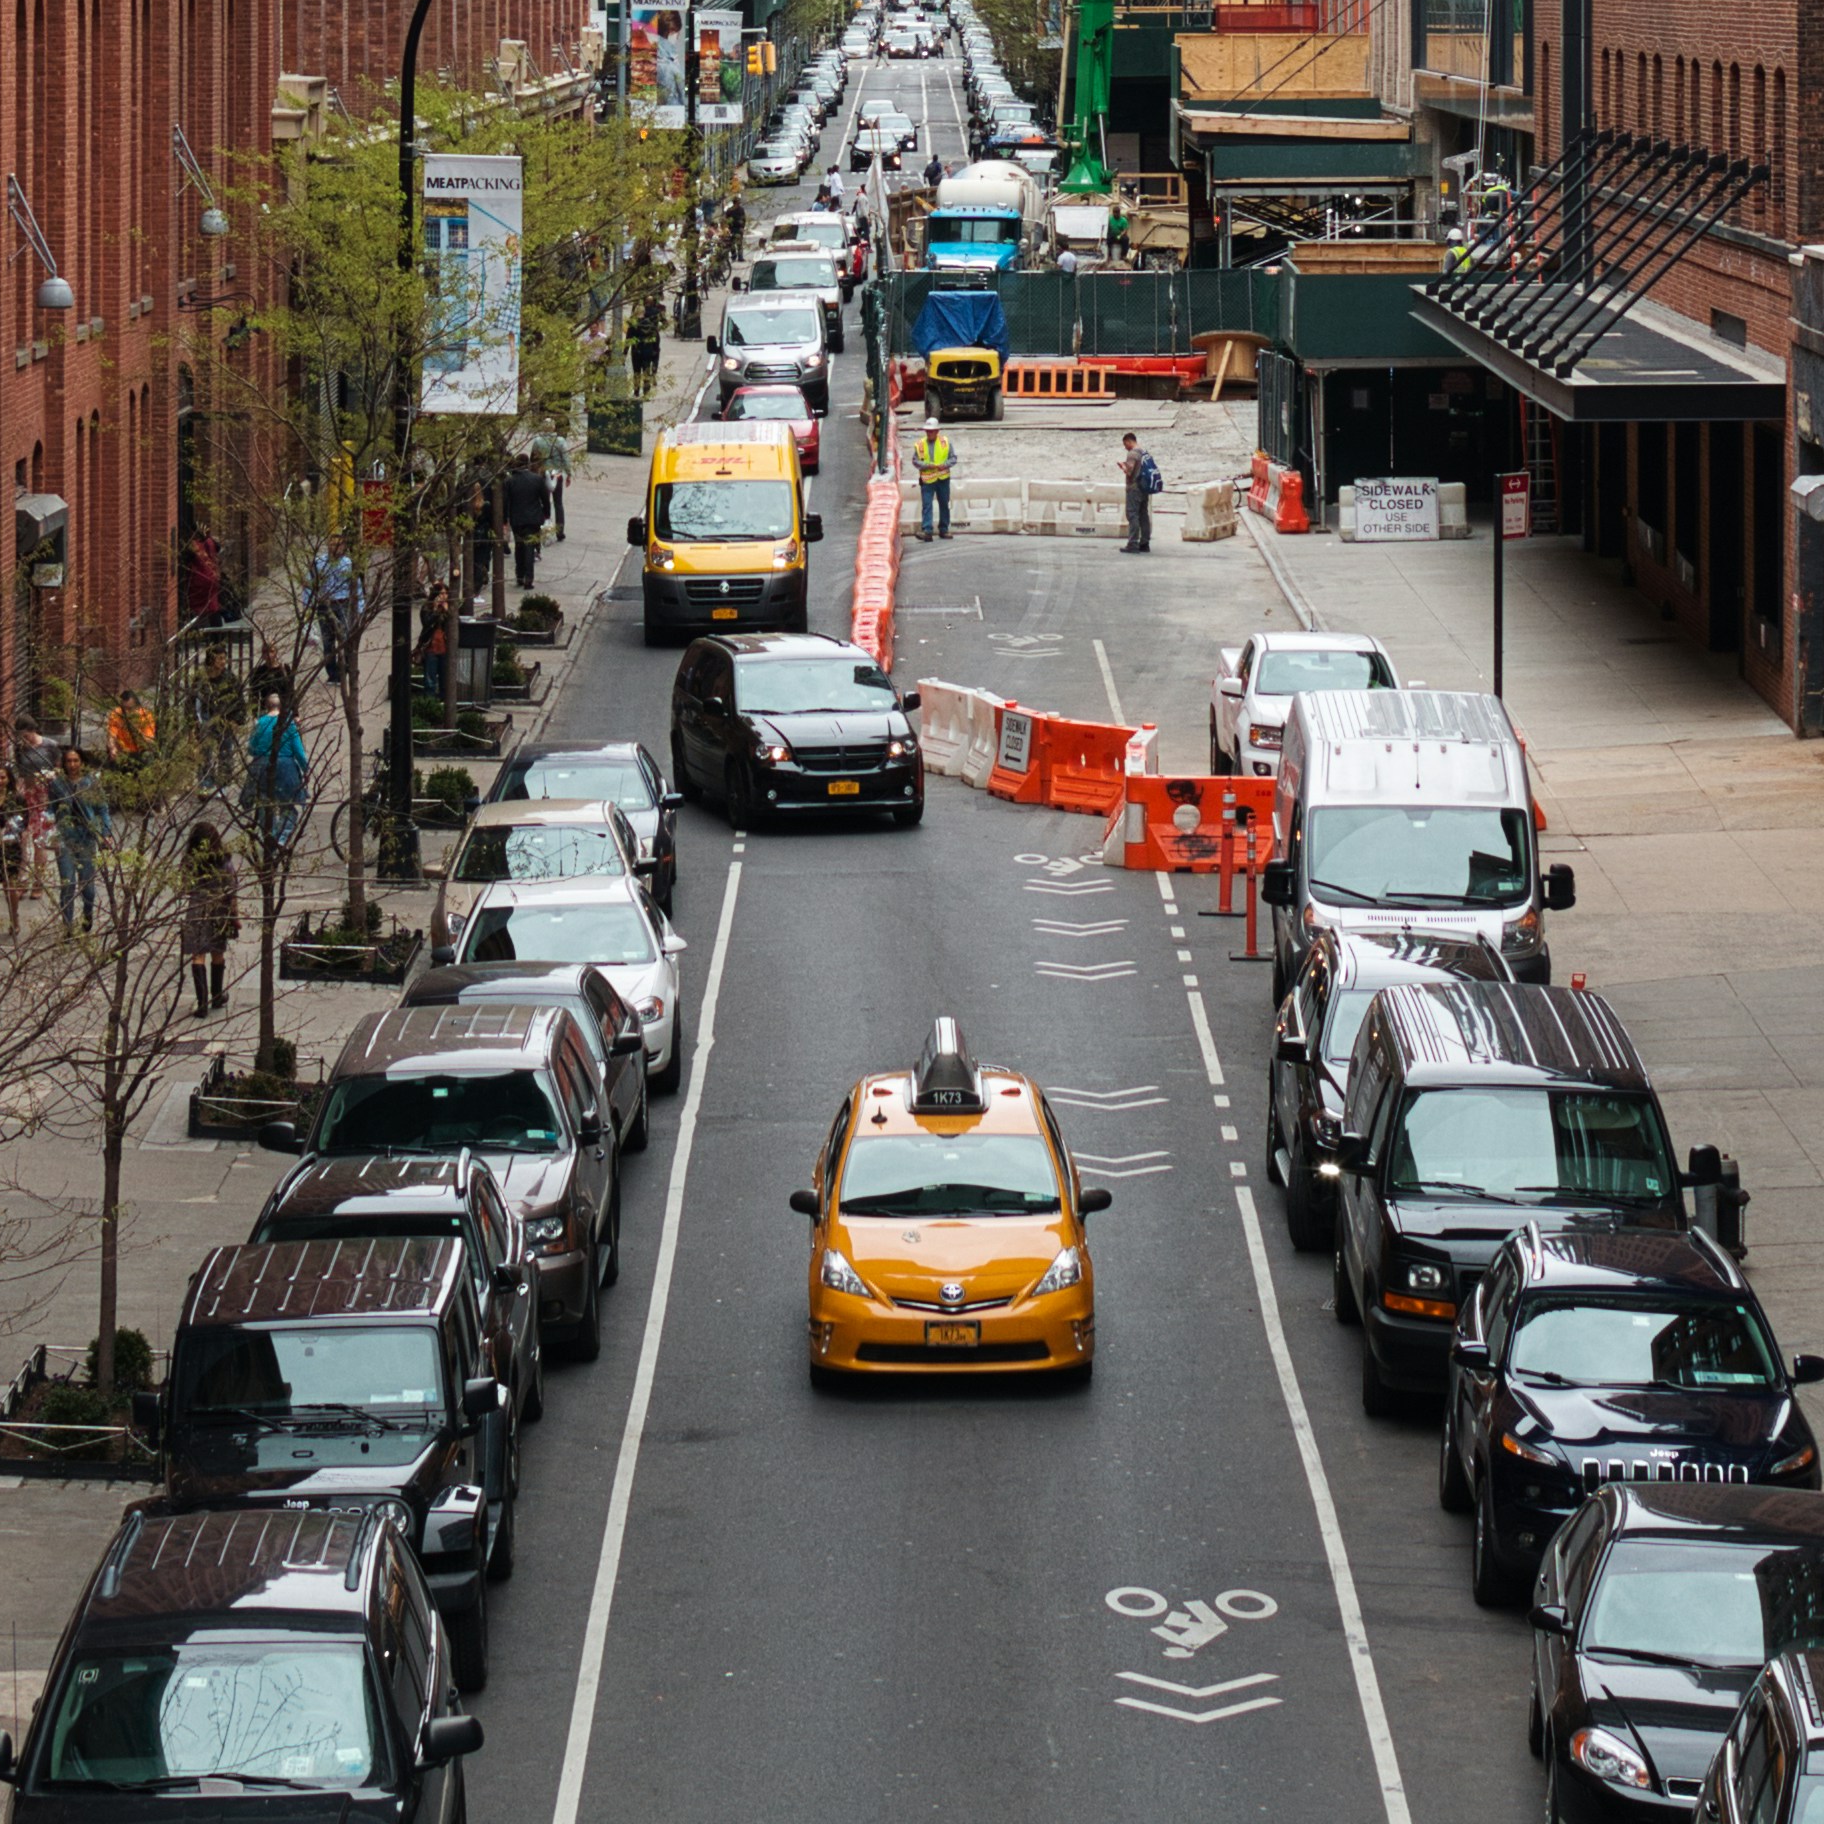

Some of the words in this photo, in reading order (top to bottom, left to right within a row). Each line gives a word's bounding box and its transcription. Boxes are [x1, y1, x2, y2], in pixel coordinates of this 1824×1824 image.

[426, 176, 520, 191] MEATPACKING
[700, 457, 744, 465] DHL
[1362, 484, 1431, 496] SIDEWALK
[1369, 498, 1424, 510] CLOSED
[1385, 512, 1408, 522] USE
[1363, 523, 1402, 534] OTHER
[1404, 523, 1430, 533] SIDE
[932, 1091, 962, 1105] 1K73
[1649, 1448, 1680, 1460] Jeep
[282, 1499, 310, 1511] Jeep
